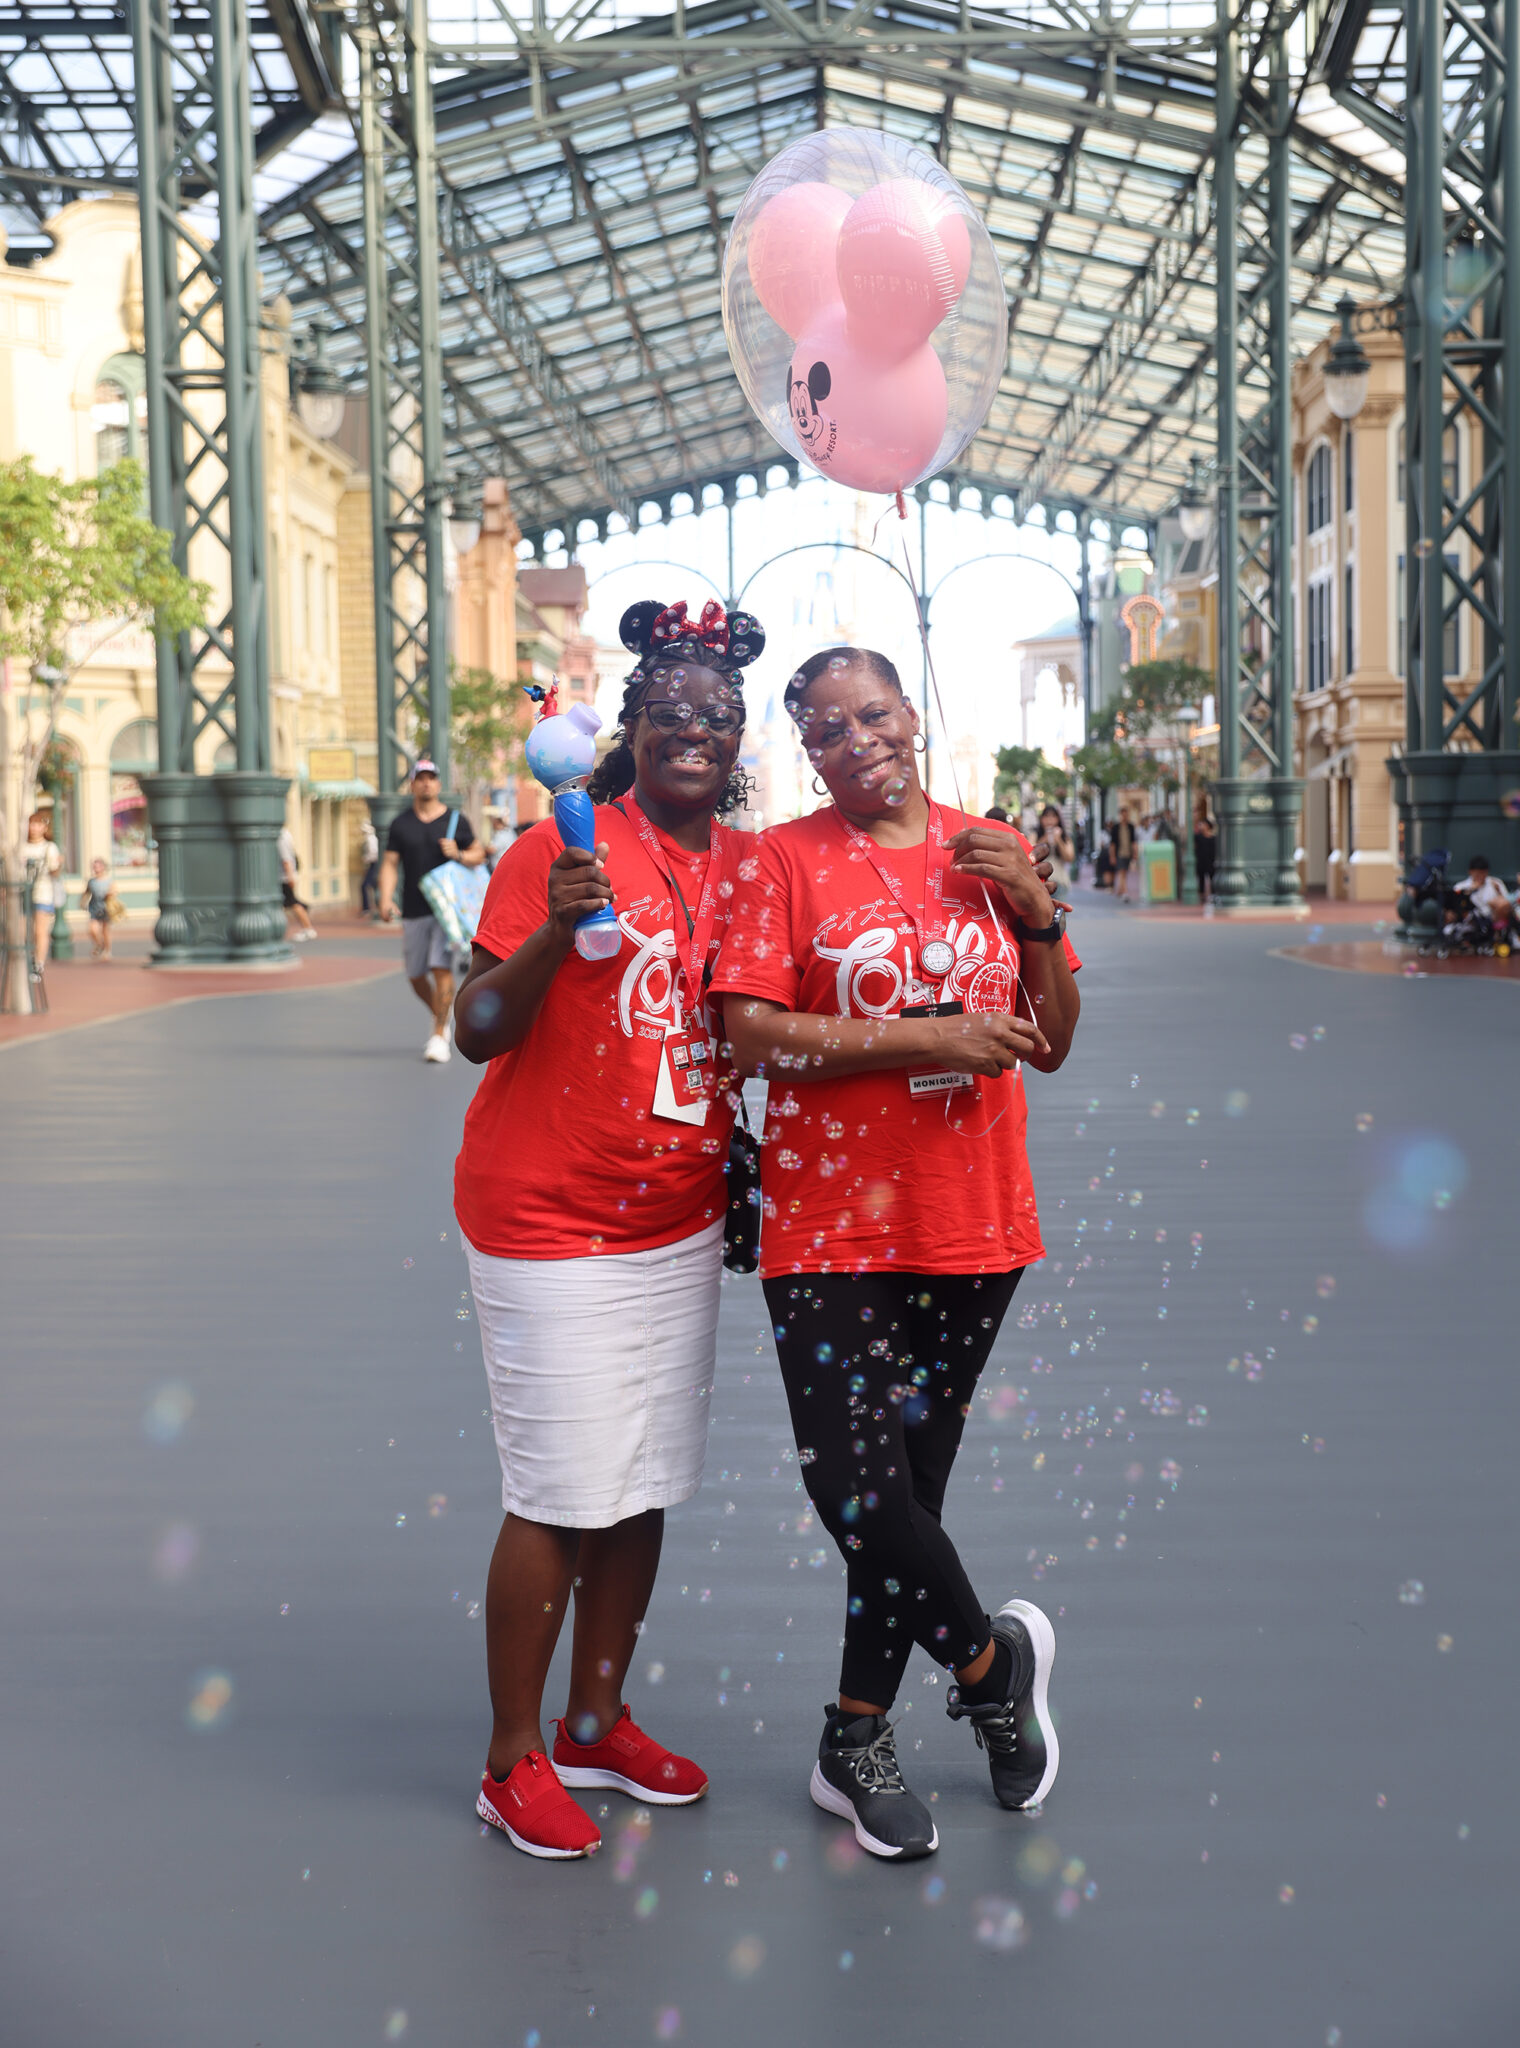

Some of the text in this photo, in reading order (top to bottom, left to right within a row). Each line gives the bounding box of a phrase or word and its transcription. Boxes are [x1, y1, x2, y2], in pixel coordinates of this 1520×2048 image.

[827, 422, 837, 453] RESORT
[644, 826, 662, 851] SPARKS
[703, 883, 711, 905] SPARKS
[878, 865, 904, 900] SPARKS FLY
[708, 897, 717, 907] let
